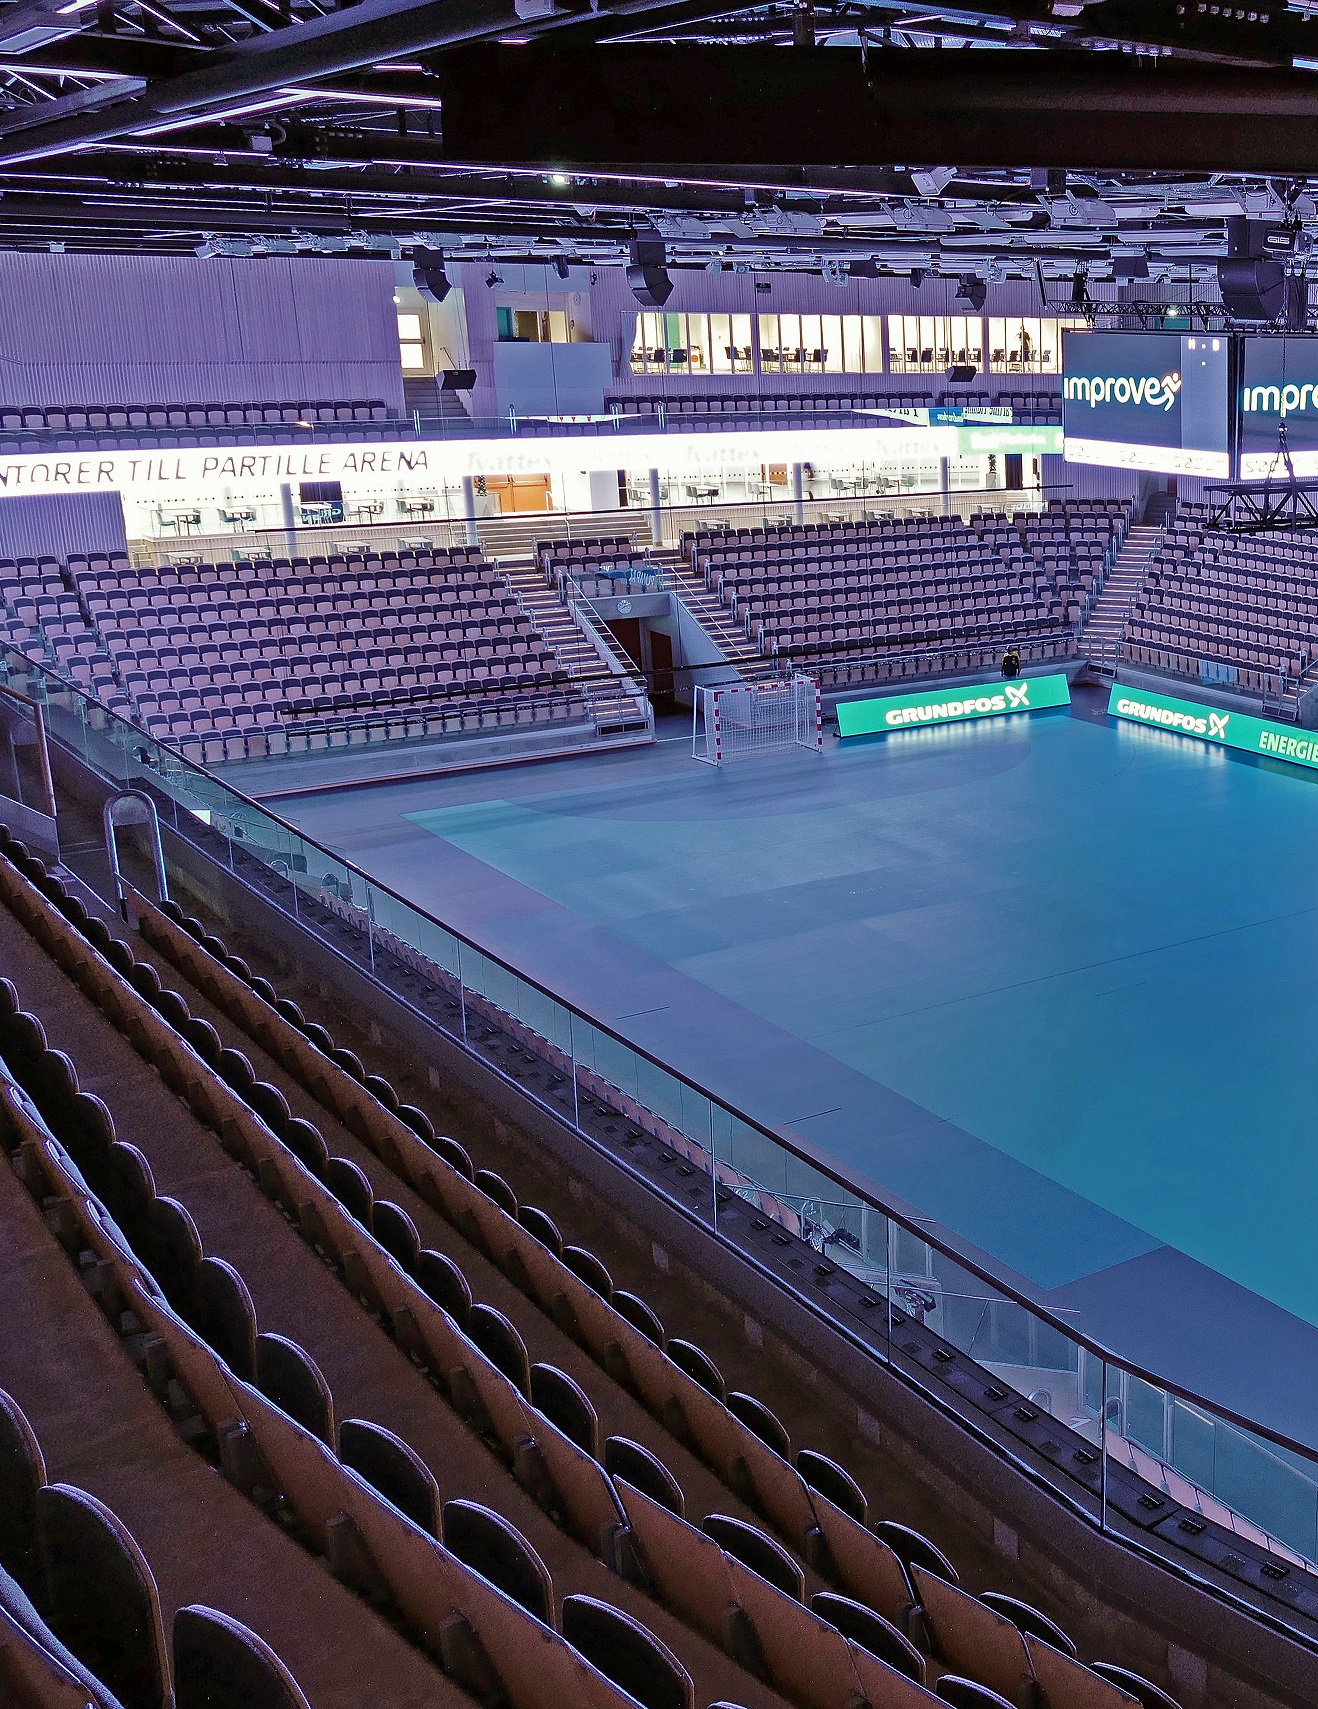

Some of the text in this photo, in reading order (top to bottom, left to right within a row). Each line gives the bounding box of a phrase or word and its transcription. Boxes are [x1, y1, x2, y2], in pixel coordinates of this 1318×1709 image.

[1267, 235, 1290, 245] GIS
[1063, 376, 1164, 409] improve
[127, 458, 187, 481] TILL
[201, 453, 331, 479] PARTILLE
[342, 450, 428, 473] ARENA
[884, 695, 1006, 726] GRUNDFOS
[1116, 698, 1207, 734] GRUNDFOS
